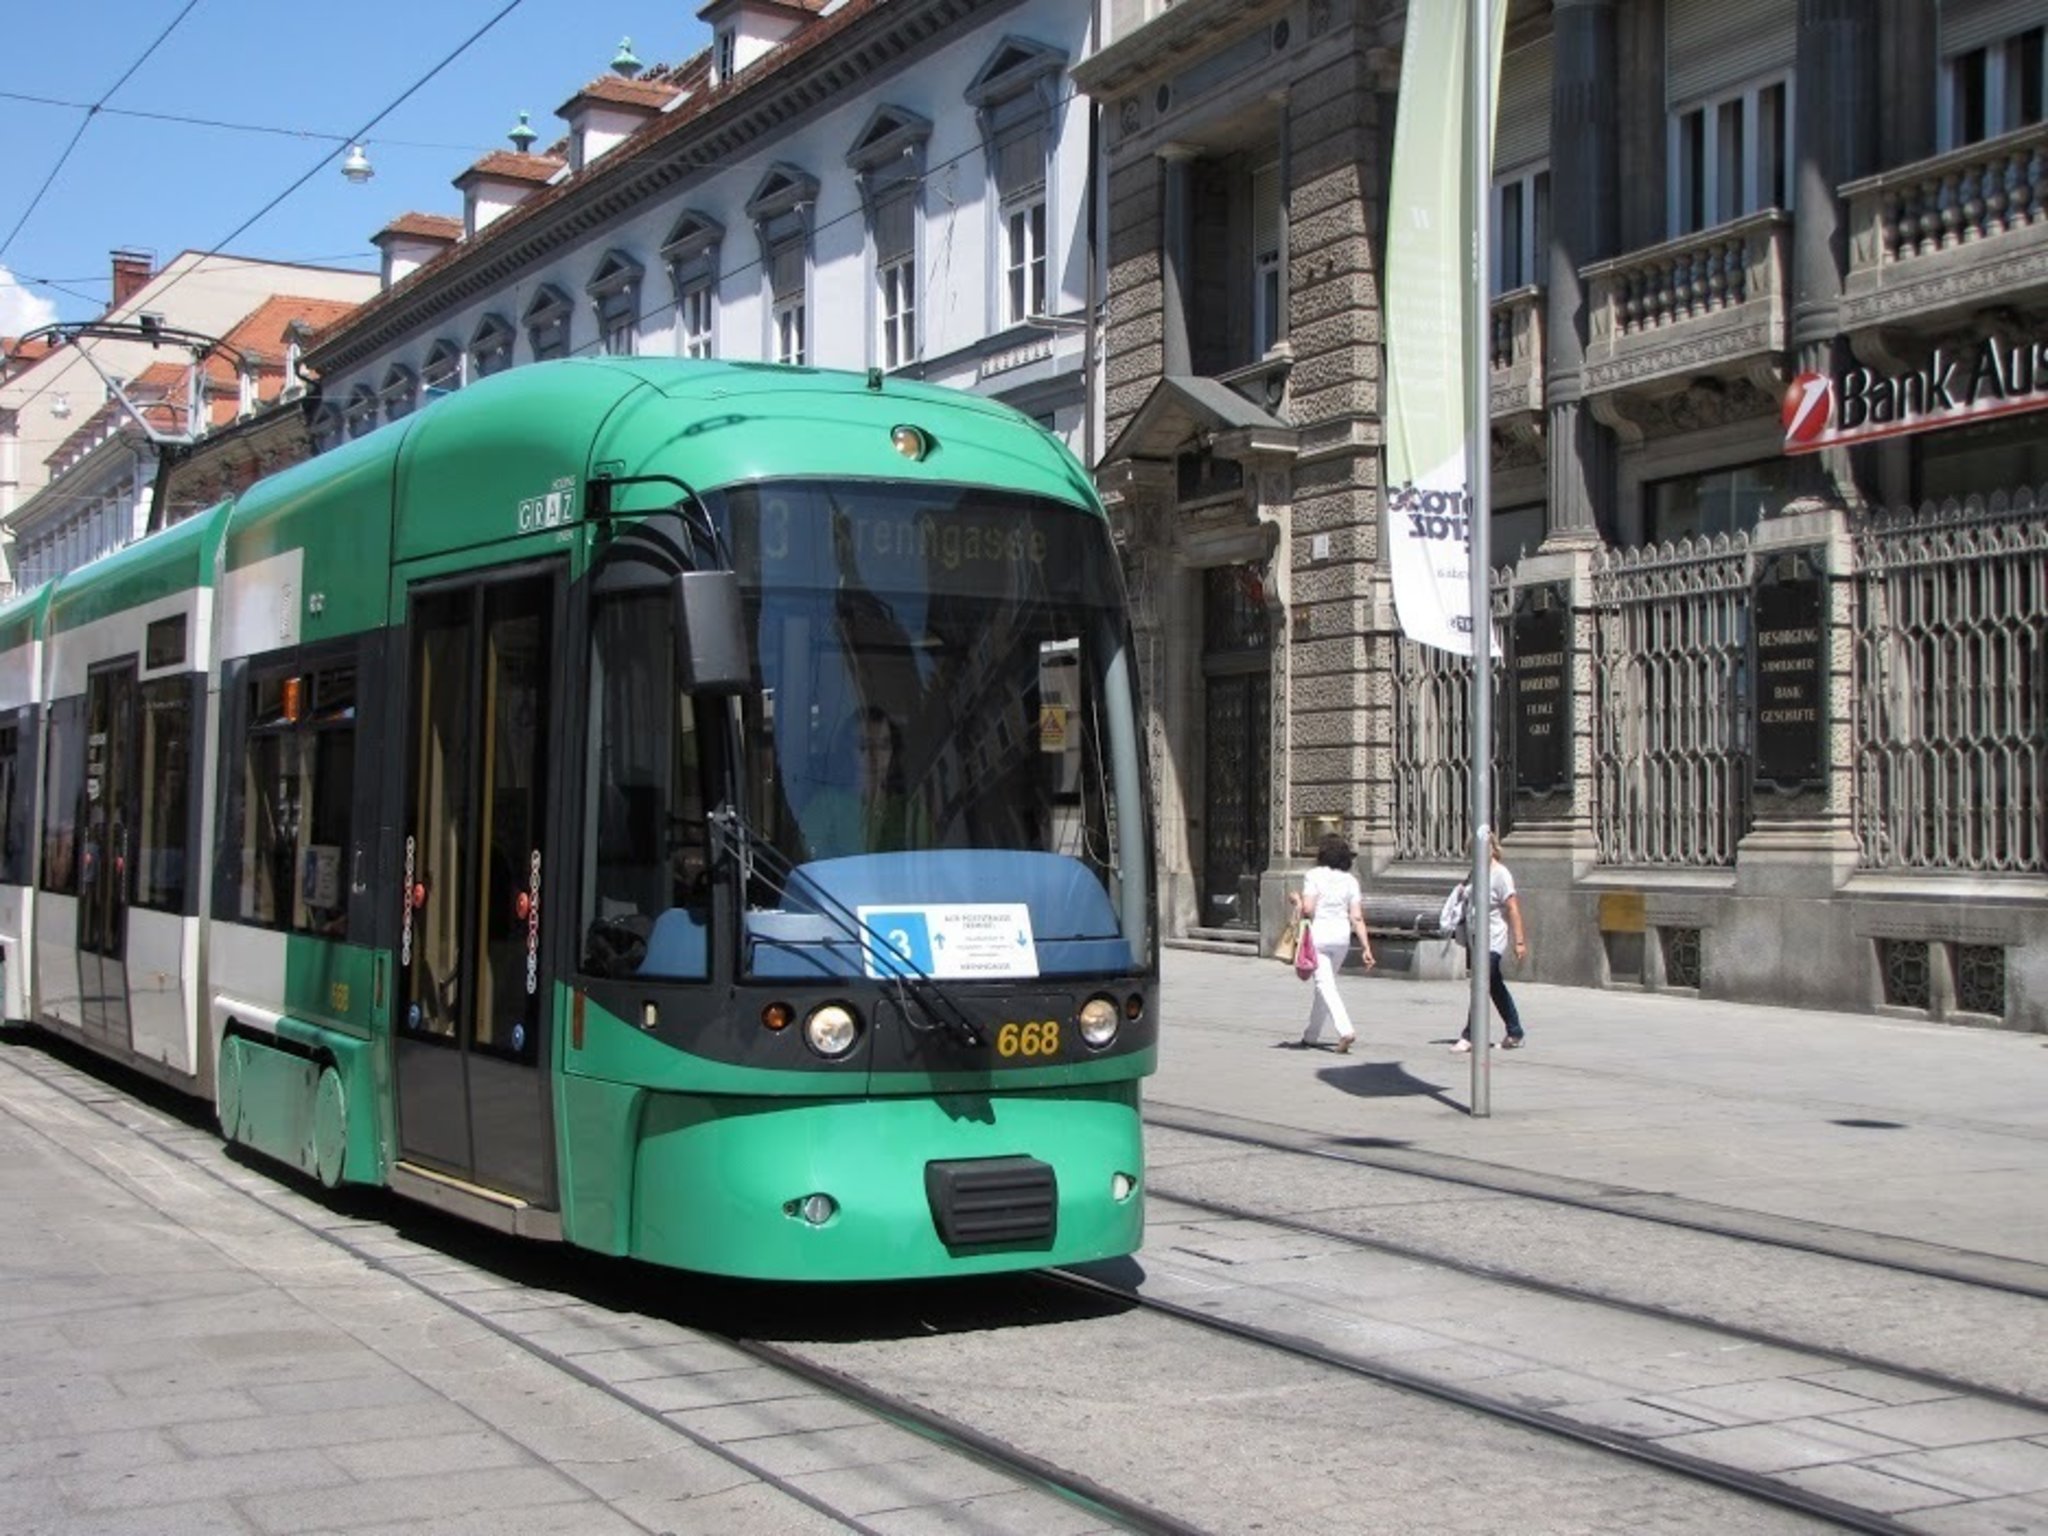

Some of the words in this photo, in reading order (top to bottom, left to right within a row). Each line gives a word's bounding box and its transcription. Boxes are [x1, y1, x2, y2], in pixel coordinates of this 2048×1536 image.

[1838, 348, 1957, 430] Bank
[519, 490, 575, 531] GRAZ
[765, 498, 789, 559] 3
[888, 928, 912, 962] 3
[998, 1021, 1060, 1057] 668
